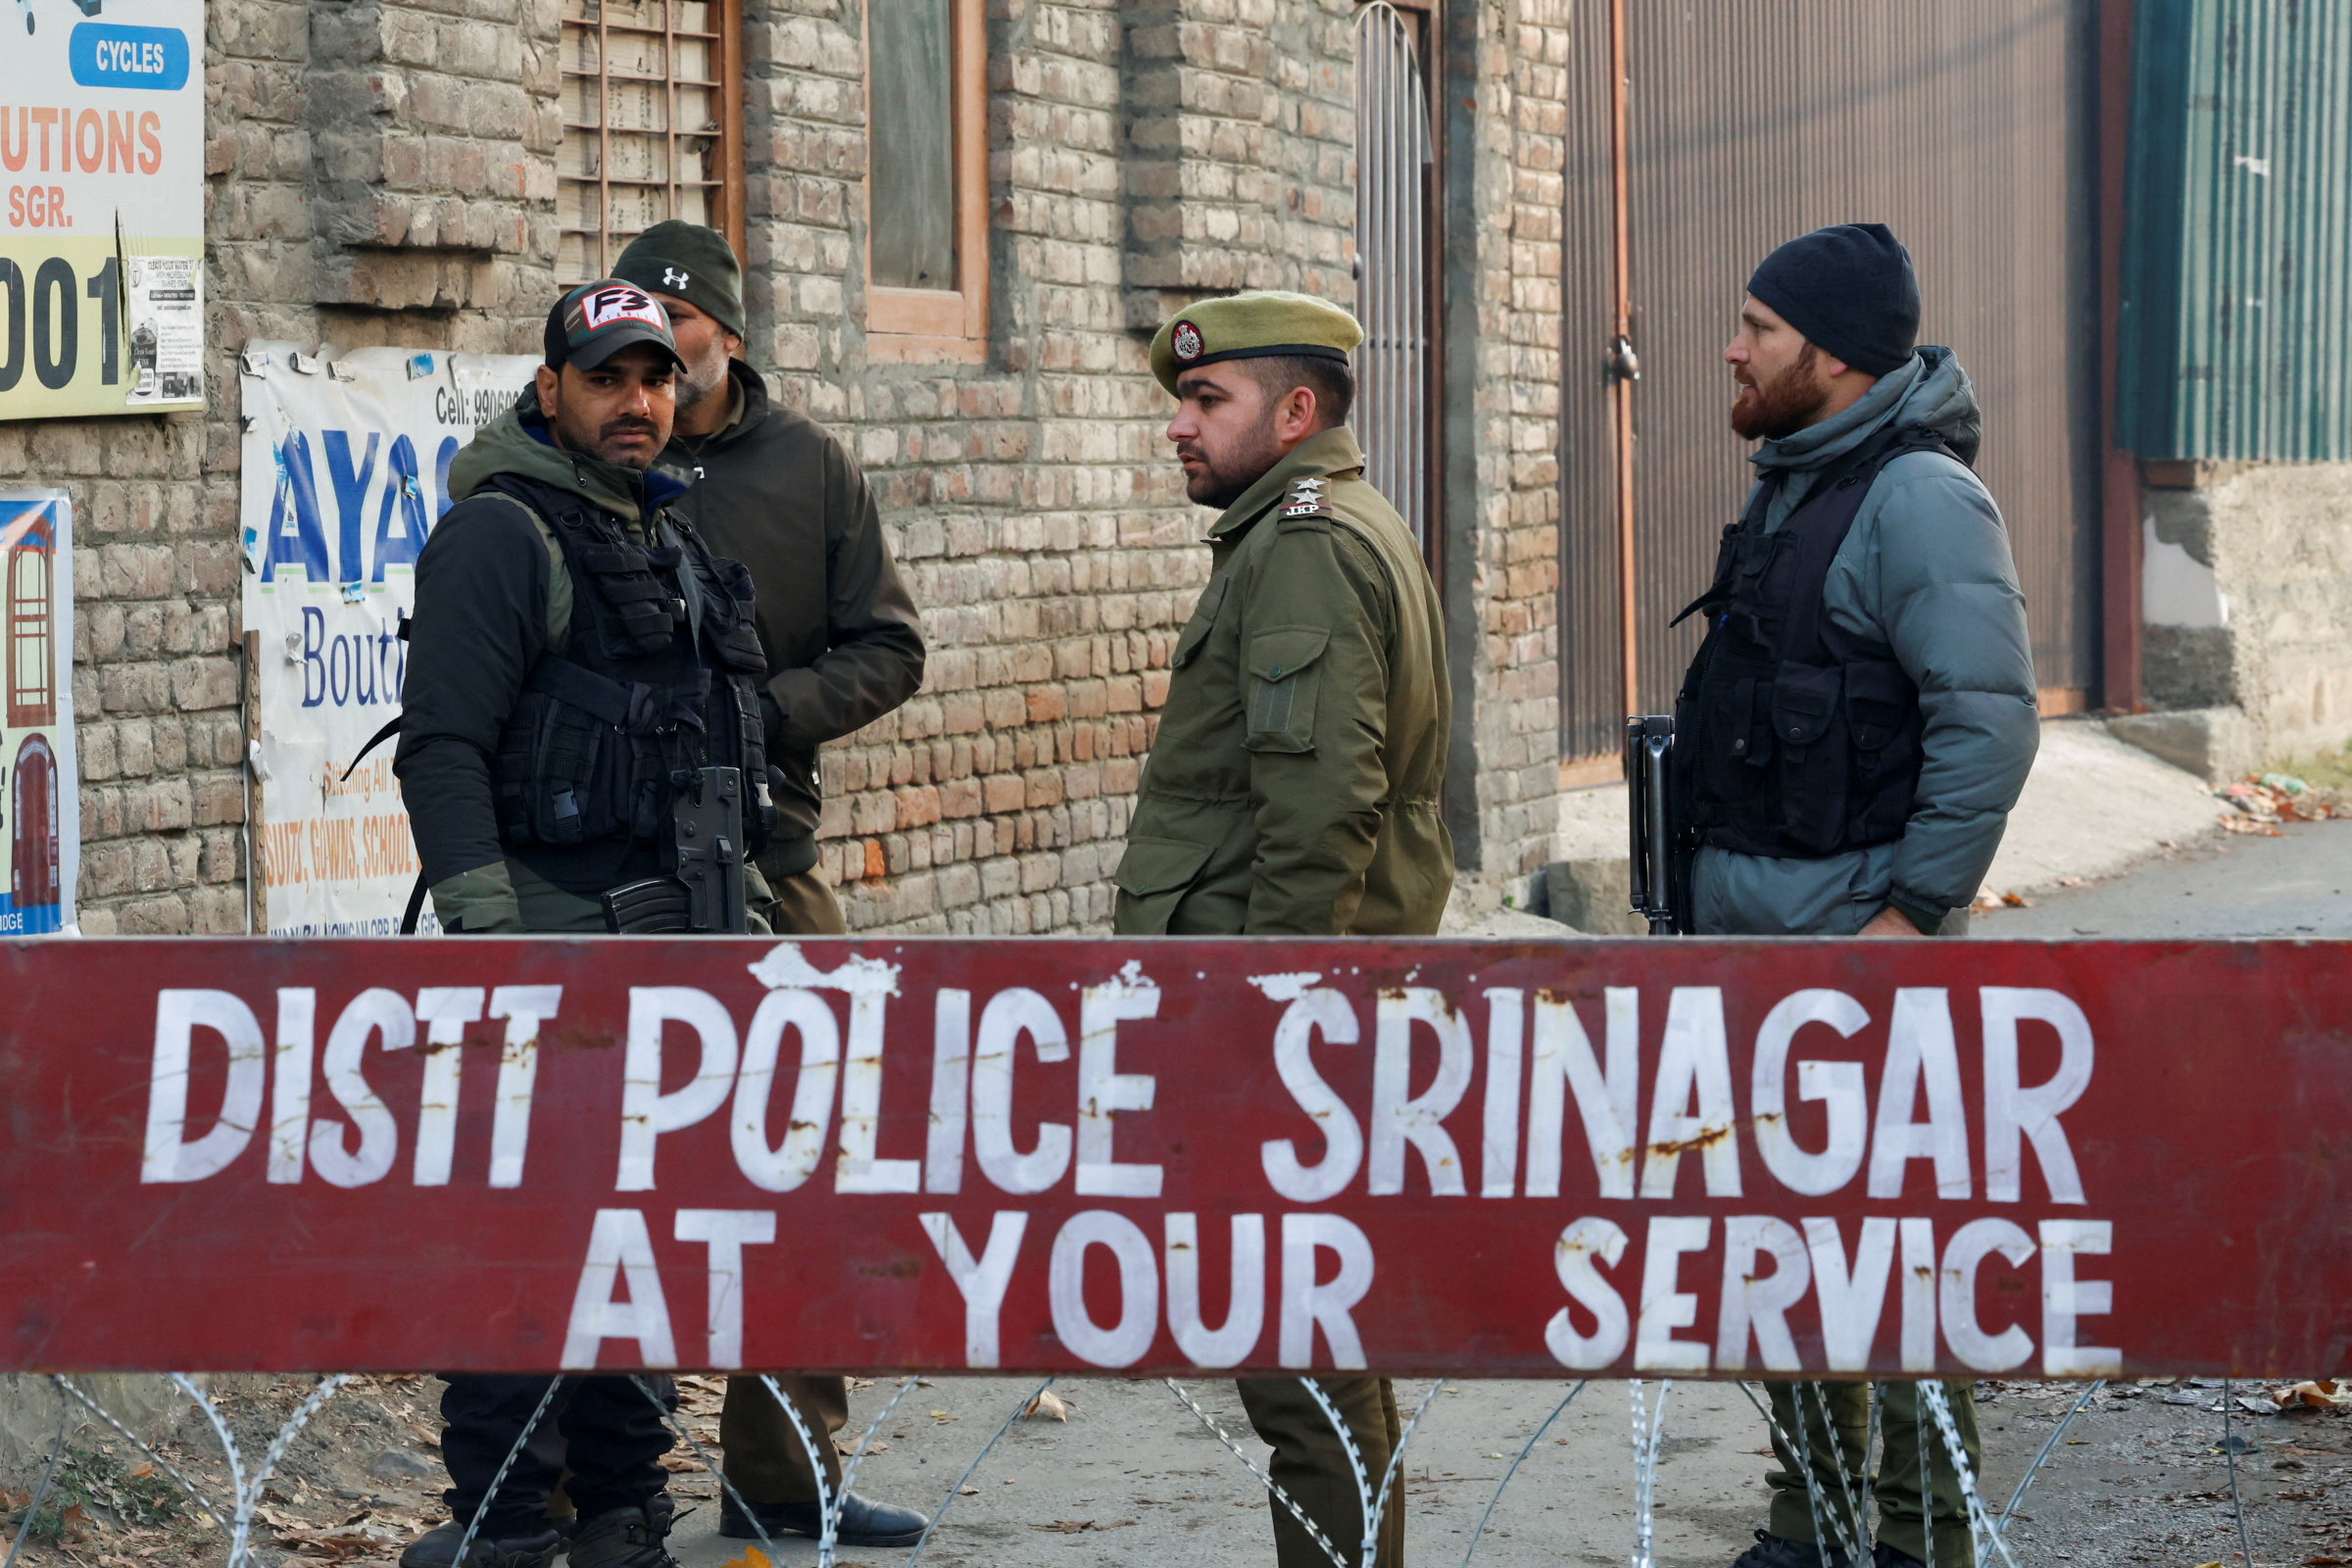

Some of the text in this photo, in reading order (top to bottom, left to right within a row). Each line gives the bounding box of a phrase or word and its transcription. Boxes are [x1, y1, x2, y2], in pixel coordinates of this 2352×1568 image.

[96, 40, 165, 74] CYCLES
[0, 106, 163, 175] UTIONS
[8, 185, 73, 228] SGR.
[593, 289, 650, 321] F3
[435, 386, 469, 425] Cell:
[1286, 505, 1319, 516] JKP
[373, 758, 387, 793] All
[363, 812, 412, 879] SCHOOL
[141, 985, 2094, 1204] DISTT POLICE SRINAGAR
[561, 1208, 2123, 1376] AT YOUR SERVICE
